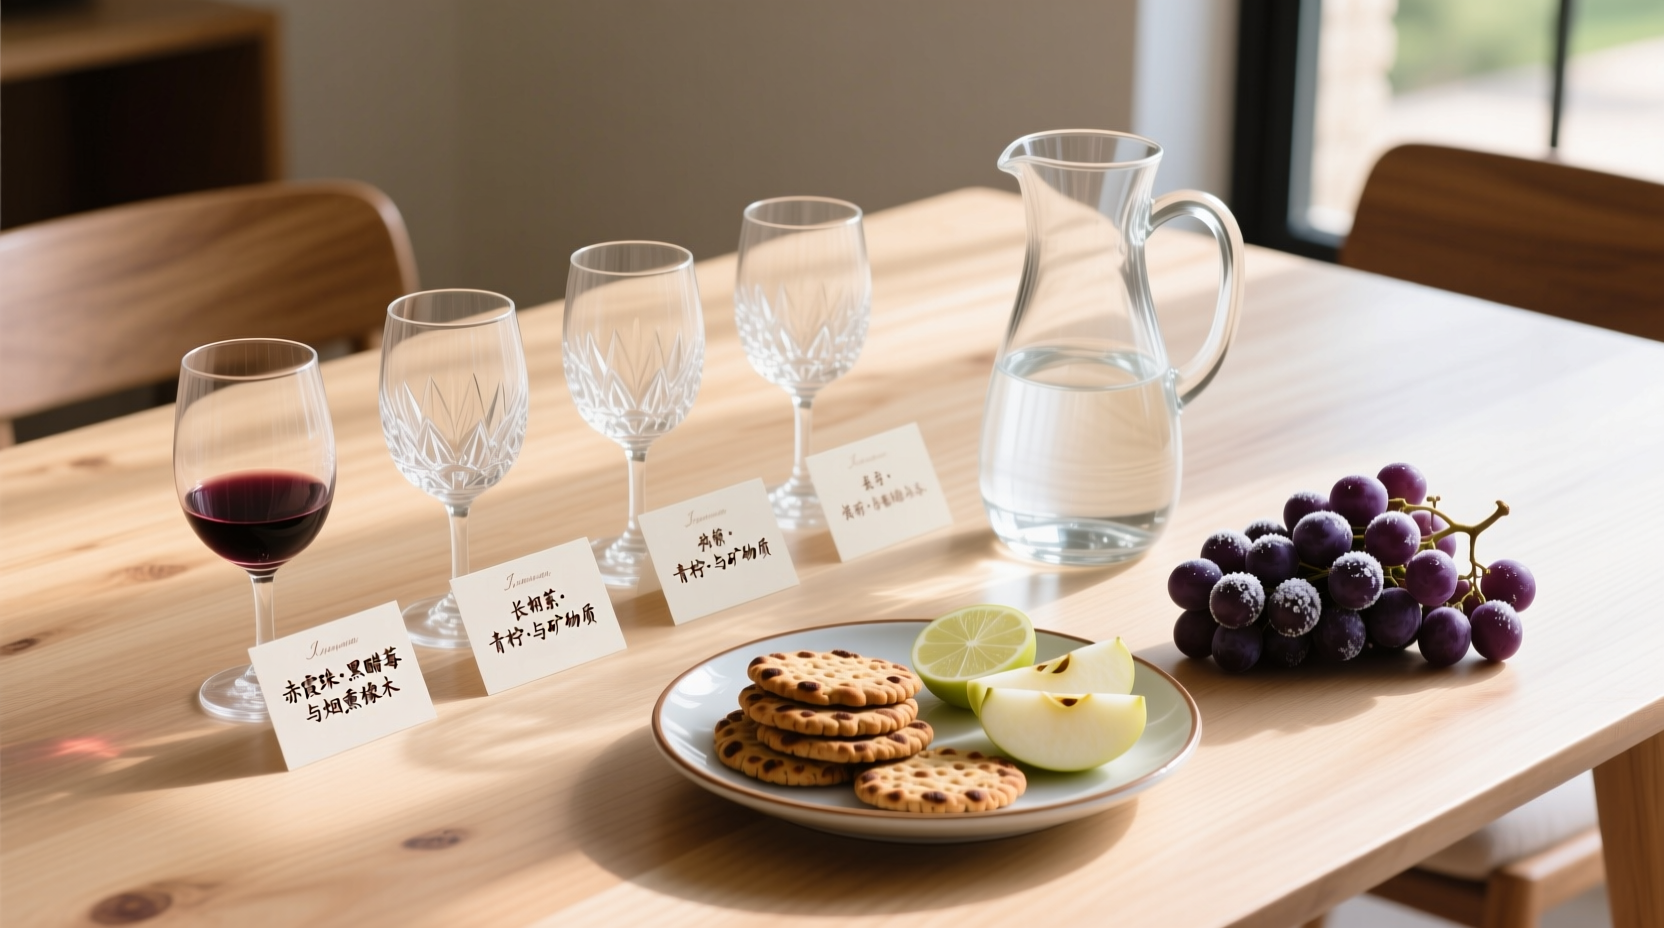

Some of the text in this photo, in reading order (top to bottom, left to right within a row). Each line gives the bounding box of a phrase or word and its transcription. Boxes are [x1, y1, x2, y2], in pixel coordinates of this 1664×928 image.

[489, 603, 597, 654] 青柠·与矿物质
